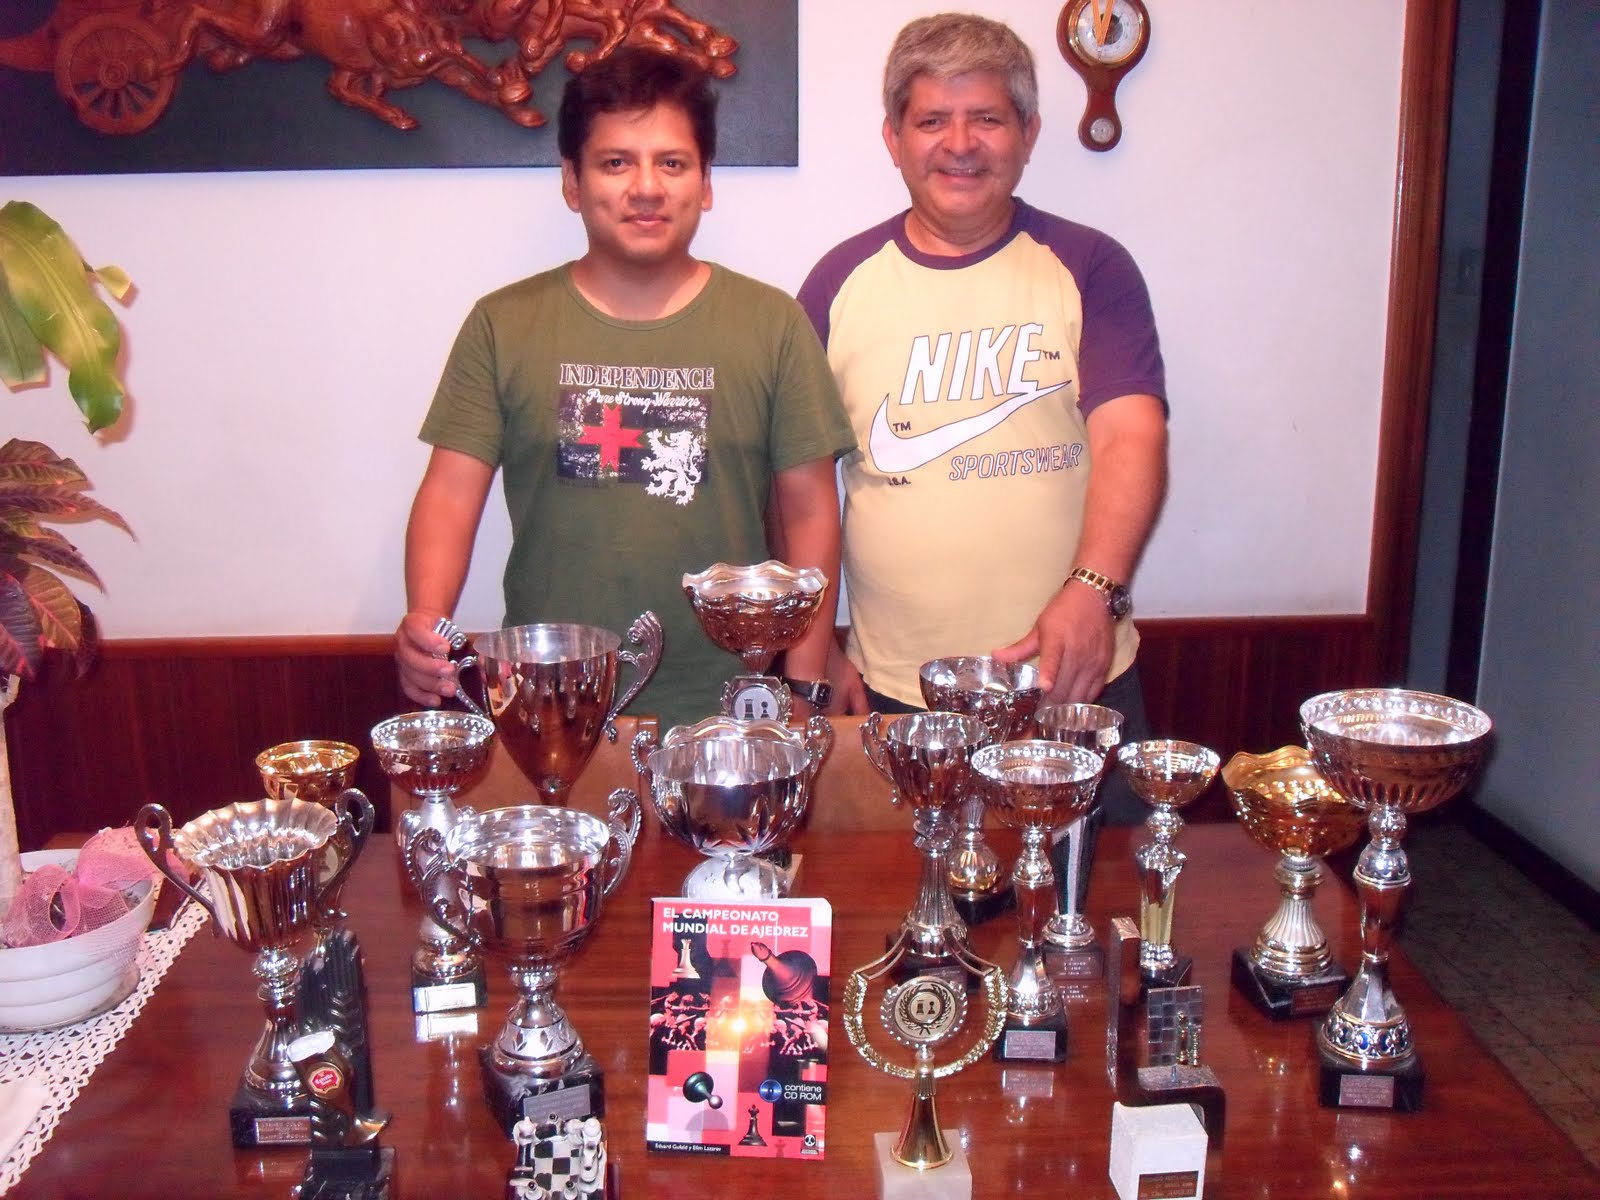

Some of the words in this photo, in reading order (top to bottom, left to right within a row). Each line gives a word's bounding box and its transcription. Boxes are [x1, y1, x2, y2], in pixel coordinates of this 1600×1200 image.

[1042, 350, 1060, 361] TM
[899, 323, 1043, 405] NIKE
[559, 363, 714, 390] INDEPENDENCE
[615, 391, 651, 414] Strong
[893, 421, 911, 433] TM
[949, 443, 1082, 480] SPORTSWEAR
[663, 908, 679, 919] EL
[682, 908, 779, 921] CAMPEONATO
[662, 922, 727, 935] MUNDIAL
[730, 924, 749, 936] DE
[751, 925, 809, 938] AJEDREZ
[784, 1084, 822, 1092] contiene
[784, 1092, 797, 1100] CD
[800, 1092, 822, 1100] ROM
